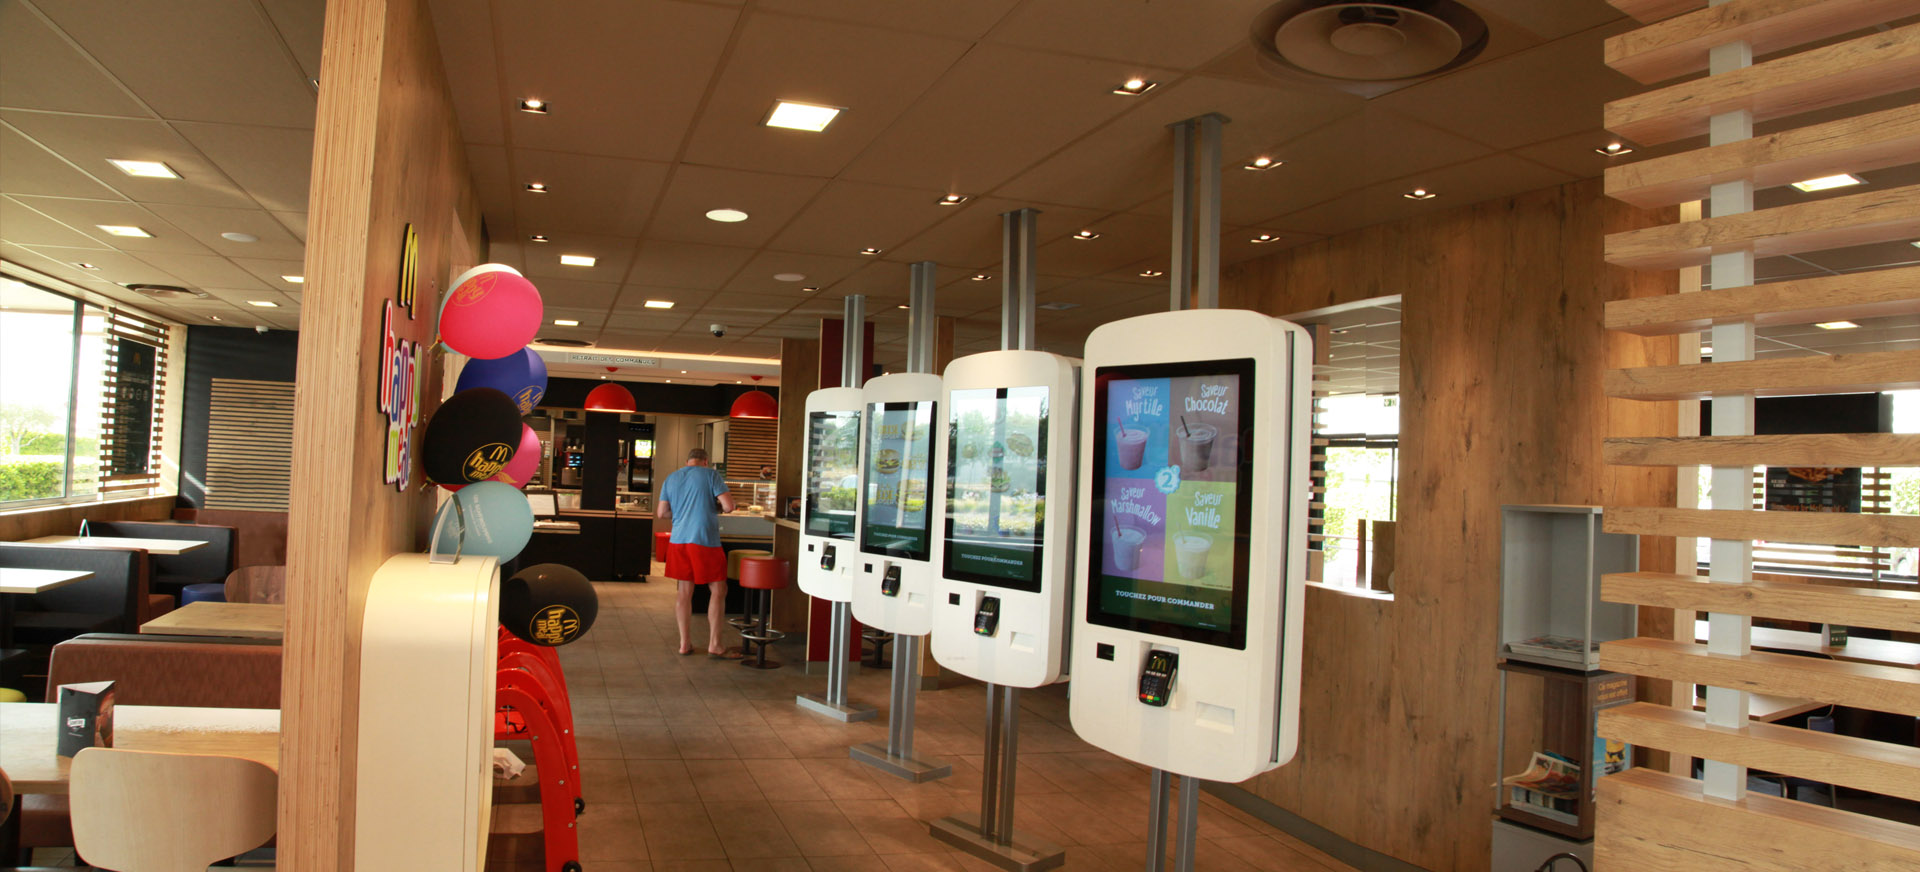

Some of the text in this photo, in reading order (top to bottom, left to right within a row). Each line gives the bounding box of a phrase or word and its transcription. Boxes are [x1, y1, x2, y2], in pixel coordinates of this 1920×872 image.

[381, 299, 422, 438] happy
[1132, 386, 1158, 400] Saveur
[1201, 384, 1228, 398] Saveur
[1125, 398, 1163, 422] Myrtille
[1185, 396, 1229, 415] Chocolat
[1121, 488, 1145, 501] Saveur
[1194, 491, 1223, 506] Saveur
[1111, 499, 1161, 526] Marshmallow
[1185, 507, 1221, 529] Vanille
[1115, 590, 1215, 610] TOUCHEZ POUR COMMANDER
[547, 608, 566, 644] happy
